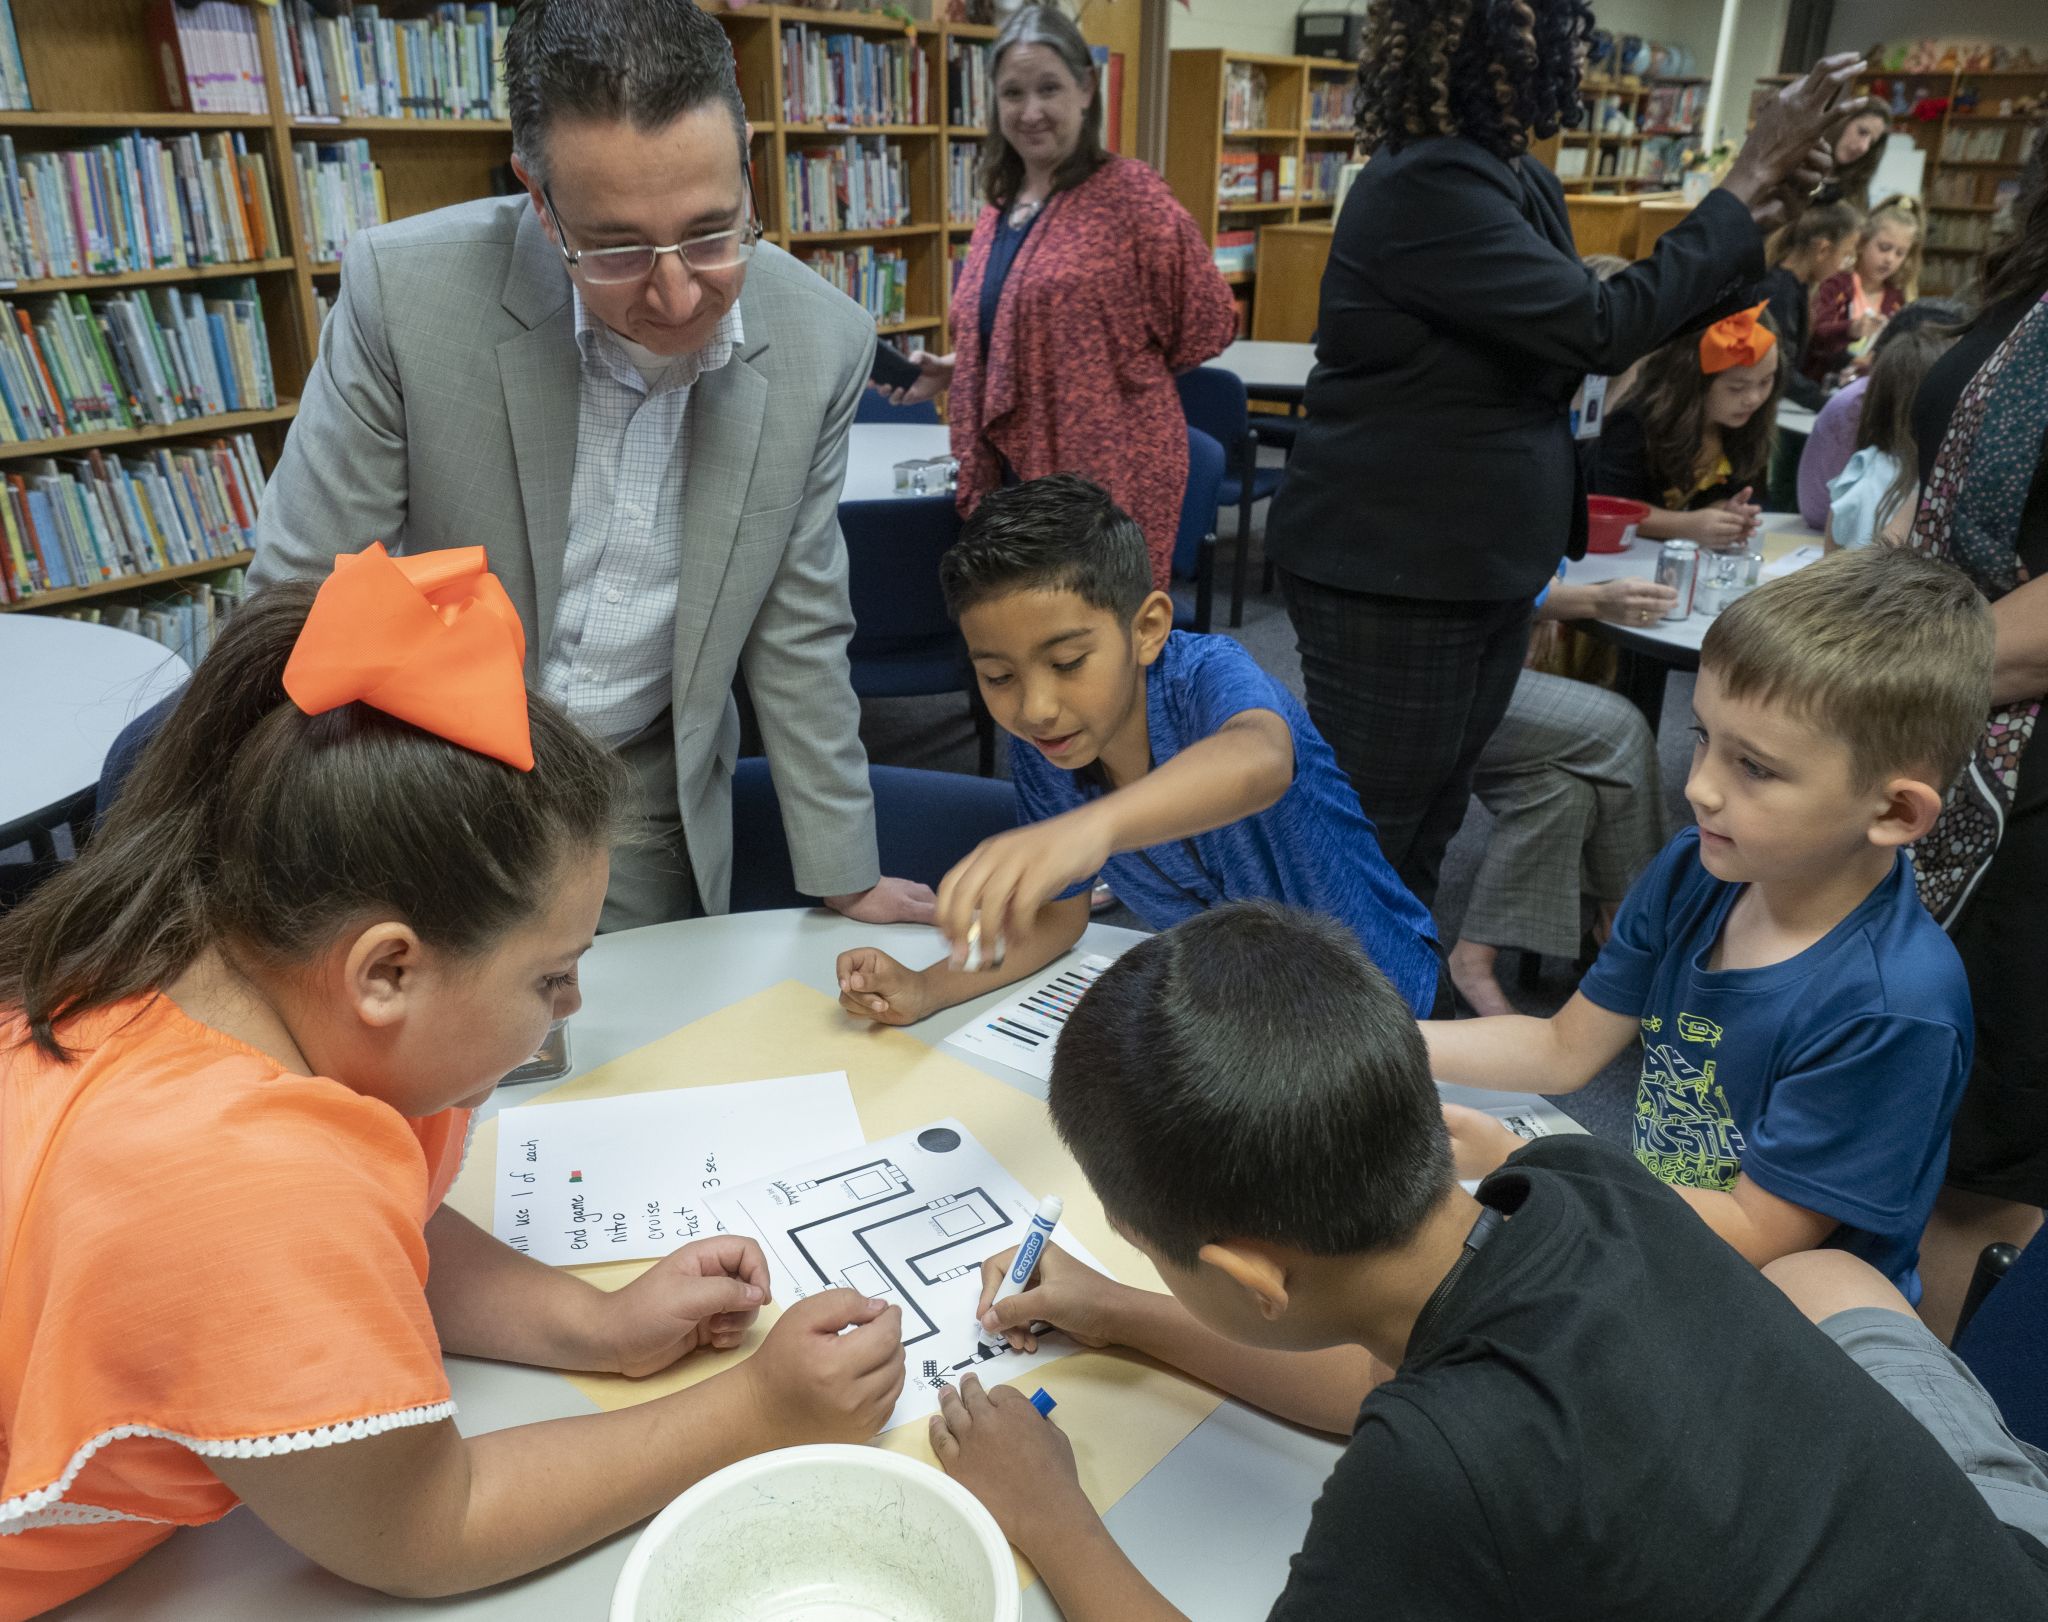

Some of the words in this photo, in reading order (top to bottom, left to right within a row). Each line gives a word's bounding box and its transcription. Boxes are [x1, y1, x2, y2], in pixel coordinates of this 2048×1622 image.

[521, 1140, 540, 1161] each
[706, 1152, 717, 1173] sec.
[510, 1172, 535, 1182] of
[702, 1177, 721, 1189] 3
[516, 1208, 529, 1227] use
[572, 1194, 603, 1223] game
[604, 1213, 629, 1243] nitro
[641, 1200, 665, 1240] cruise
[673, 1207, 700, 1237] fast
[509, 1236, 529, 1254] ill
[564, 1226, 588, 1250] end
[1014, 1236, 1039, 1280] Crayola
